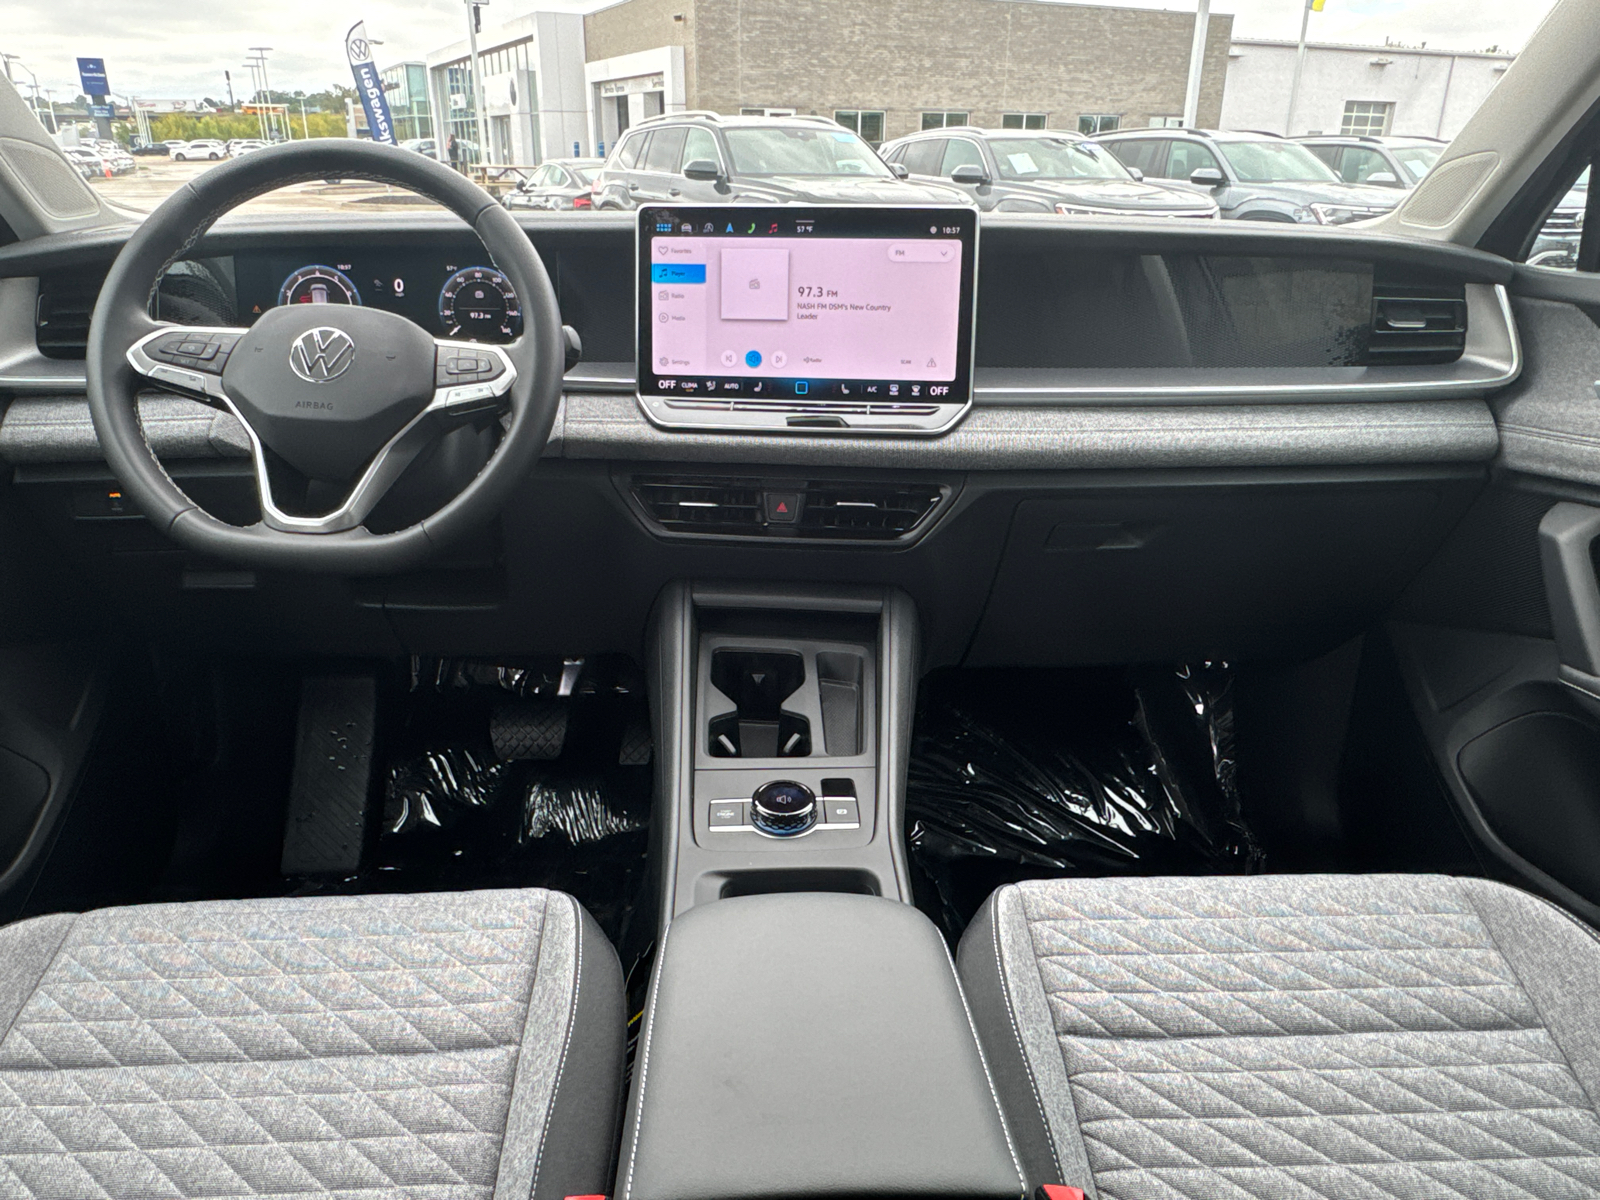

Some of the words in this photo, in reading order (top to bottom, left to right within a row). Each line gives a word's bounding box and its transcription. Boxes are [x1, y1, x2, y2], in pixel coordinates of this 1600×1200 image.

[797, 225, 805, 233] 57
[942, 226, 960, 234] 10:57
[393, 278, 404, 292] 0
[797, 286, 824, 298] 97.3
[826, 290, 838, 298] FM
[828, 303, 848, 311] DSM's
[865, 304, 891, 312] Country
[658, 380, 677, 389] OFF
[929, 386, 949, 396] OFF
[295, 401, 334, 411] AIRBAG
